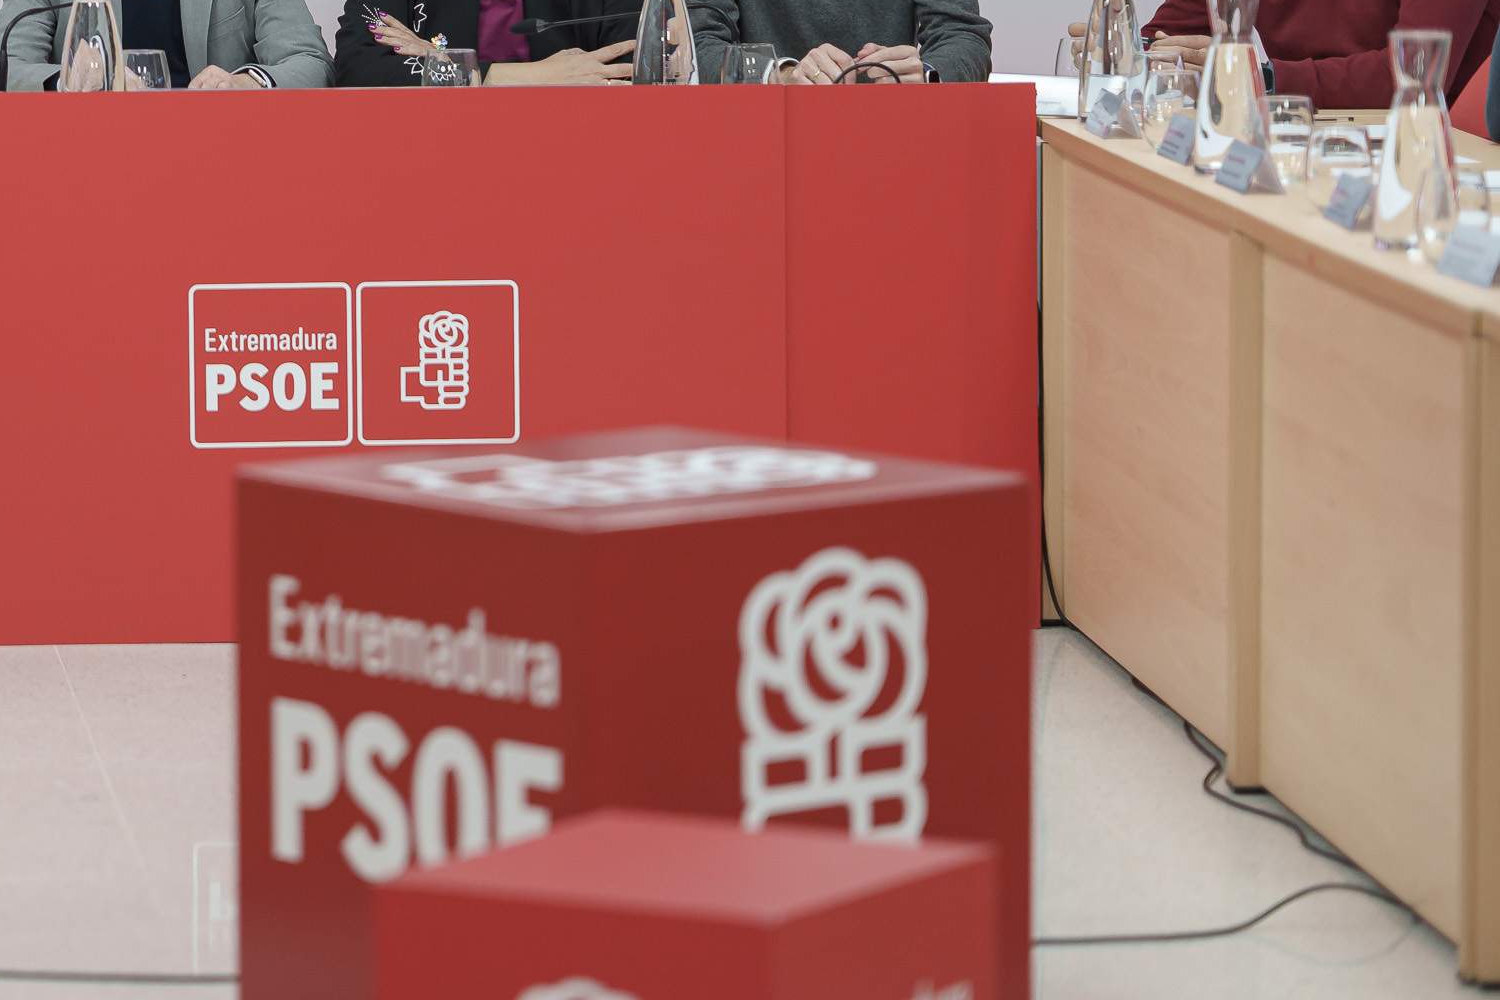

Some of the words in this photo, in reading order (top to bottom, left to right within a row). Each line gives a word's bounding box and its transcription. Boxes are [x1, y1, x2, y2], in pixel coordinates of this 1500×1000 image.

[204, 326, 338, 353] Extremadura
[205, 361, 340, 412] PSOE
[269, 573, 562, 708] Extremadura
[270, 695, 563, 884] PSOE
